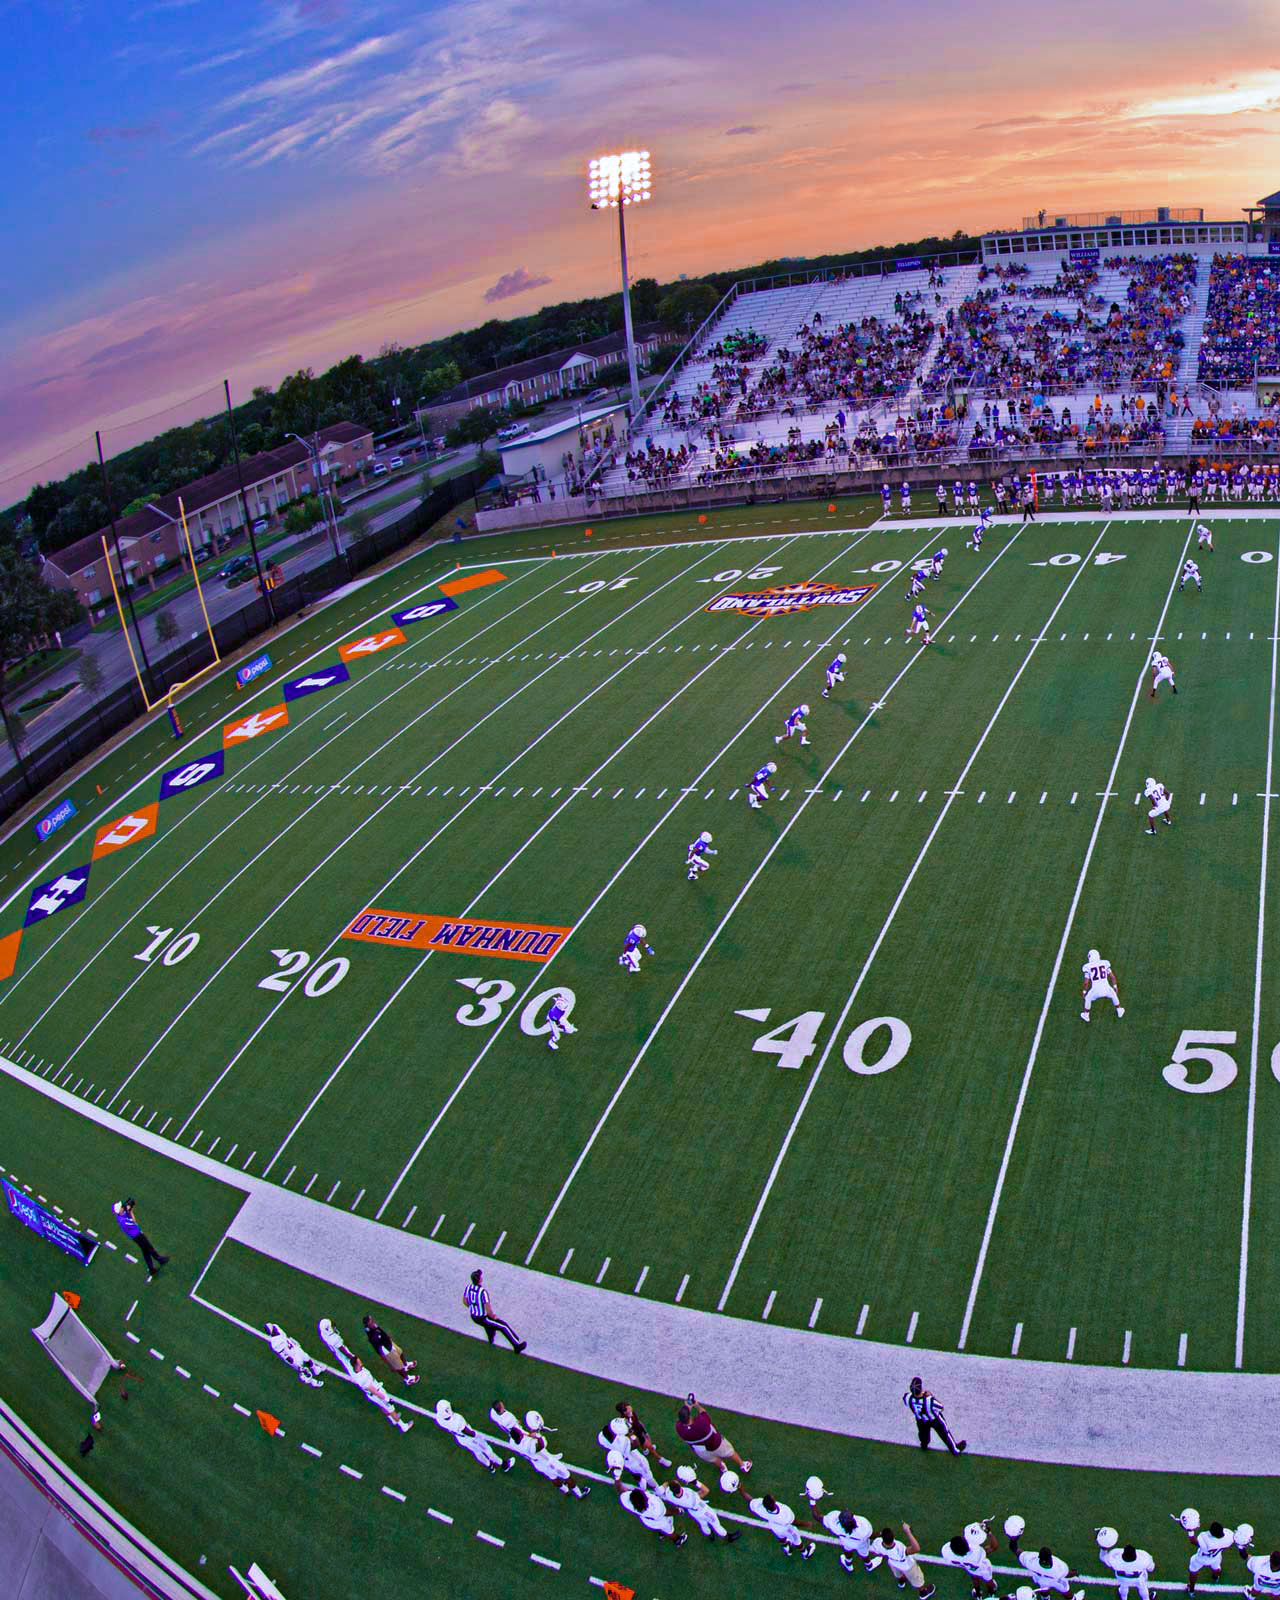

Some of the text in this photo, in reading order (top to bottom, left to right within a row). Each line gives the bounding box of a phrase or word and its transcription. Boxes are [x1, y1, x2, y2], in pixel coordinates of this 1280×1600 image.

[1049, 552, 1127, 566] 40
[576, 577, 639, 594] 10
[706, 566, 782, 583] 20
[710, 588, 870, 611] SOUTHLAND
[252, 658, 269, 675] pepsi
[52, 804, 71, 827] pepsi
[134, 926, 200, 966] 10
[350, 914, 562, 957] DUNHAM FIELD
[258, 950, 350, 997] 20
[1091, 965, 1106, 981] 26
[456, 979, 576, 1037] 30
[752, 1012, 912, 1076] 40
